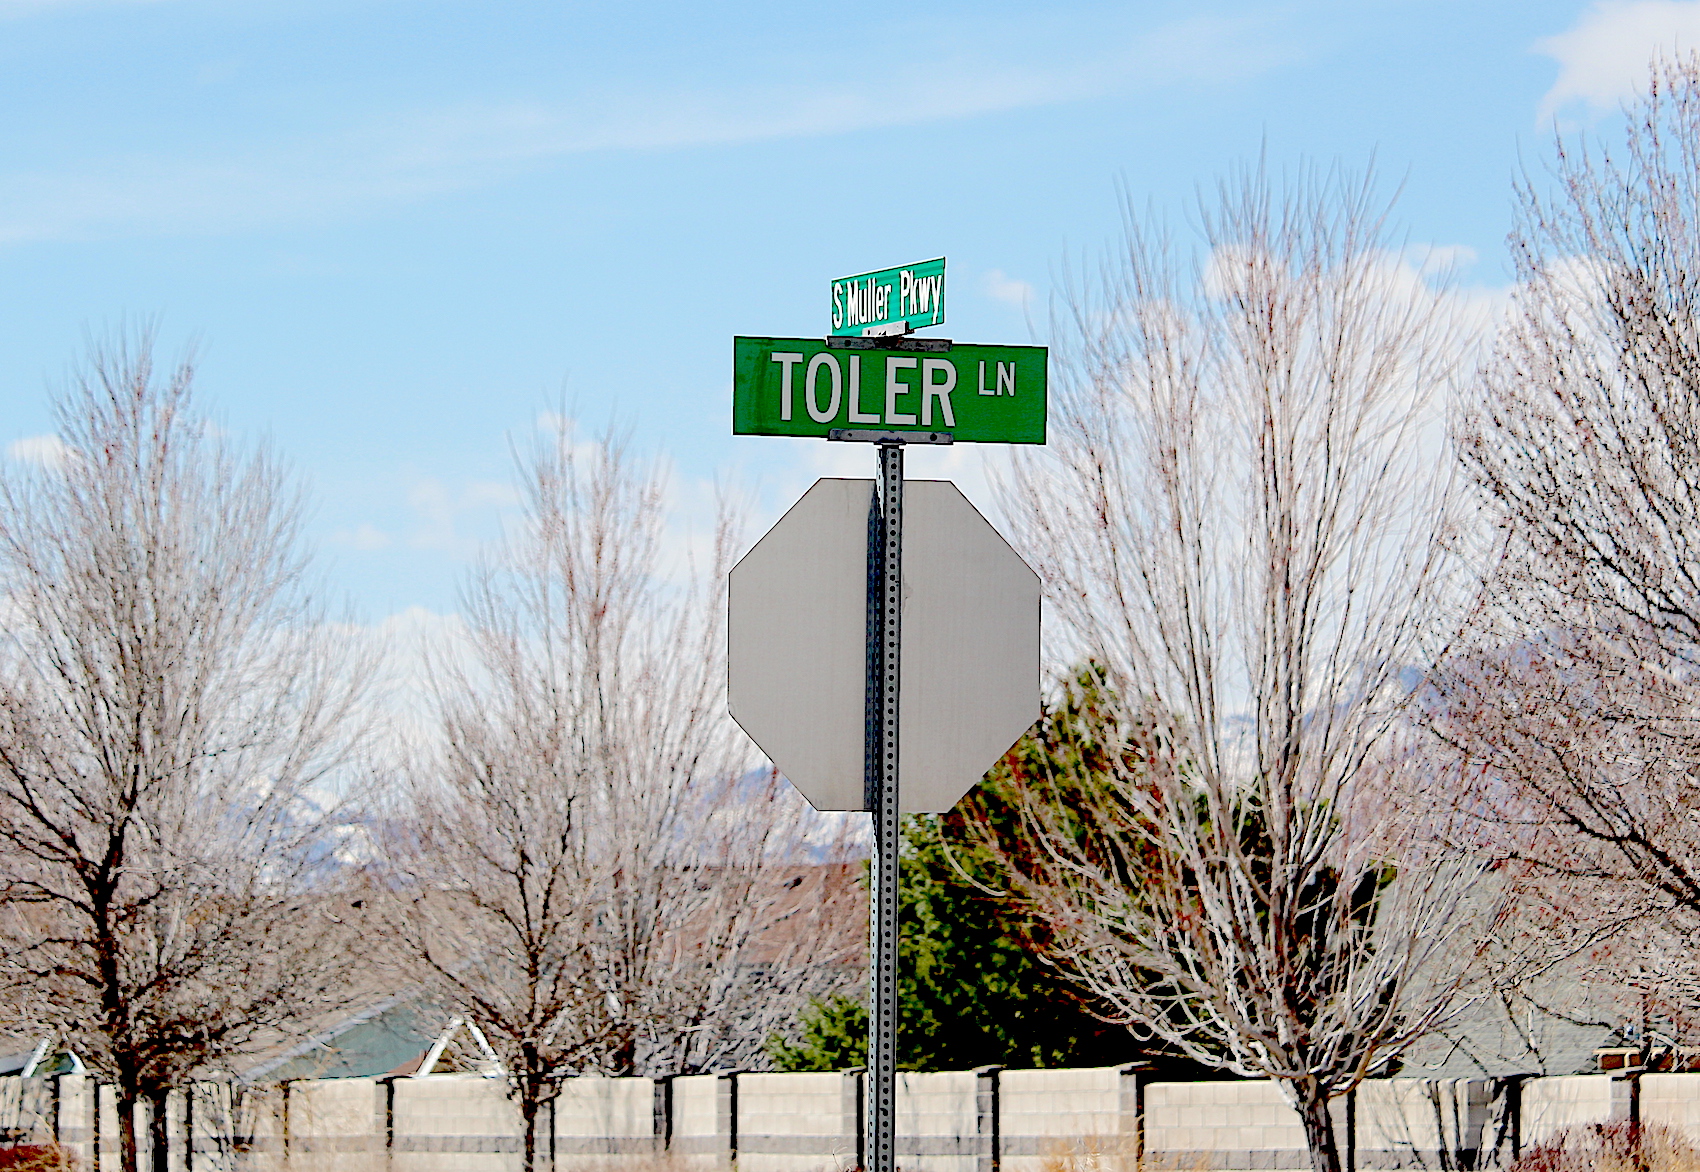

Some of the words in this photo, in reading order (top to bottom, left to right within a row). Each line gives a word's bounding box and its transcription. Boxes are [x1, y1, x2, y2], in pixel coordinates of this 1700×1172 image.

[832, 281, 844, 330] S
[846, 276, 892, 327] Muller
[899, 269, 943, 325] Pkwy
[770, 351, 957, 428] TOLER
[978, 360, 1016, 397] LN
